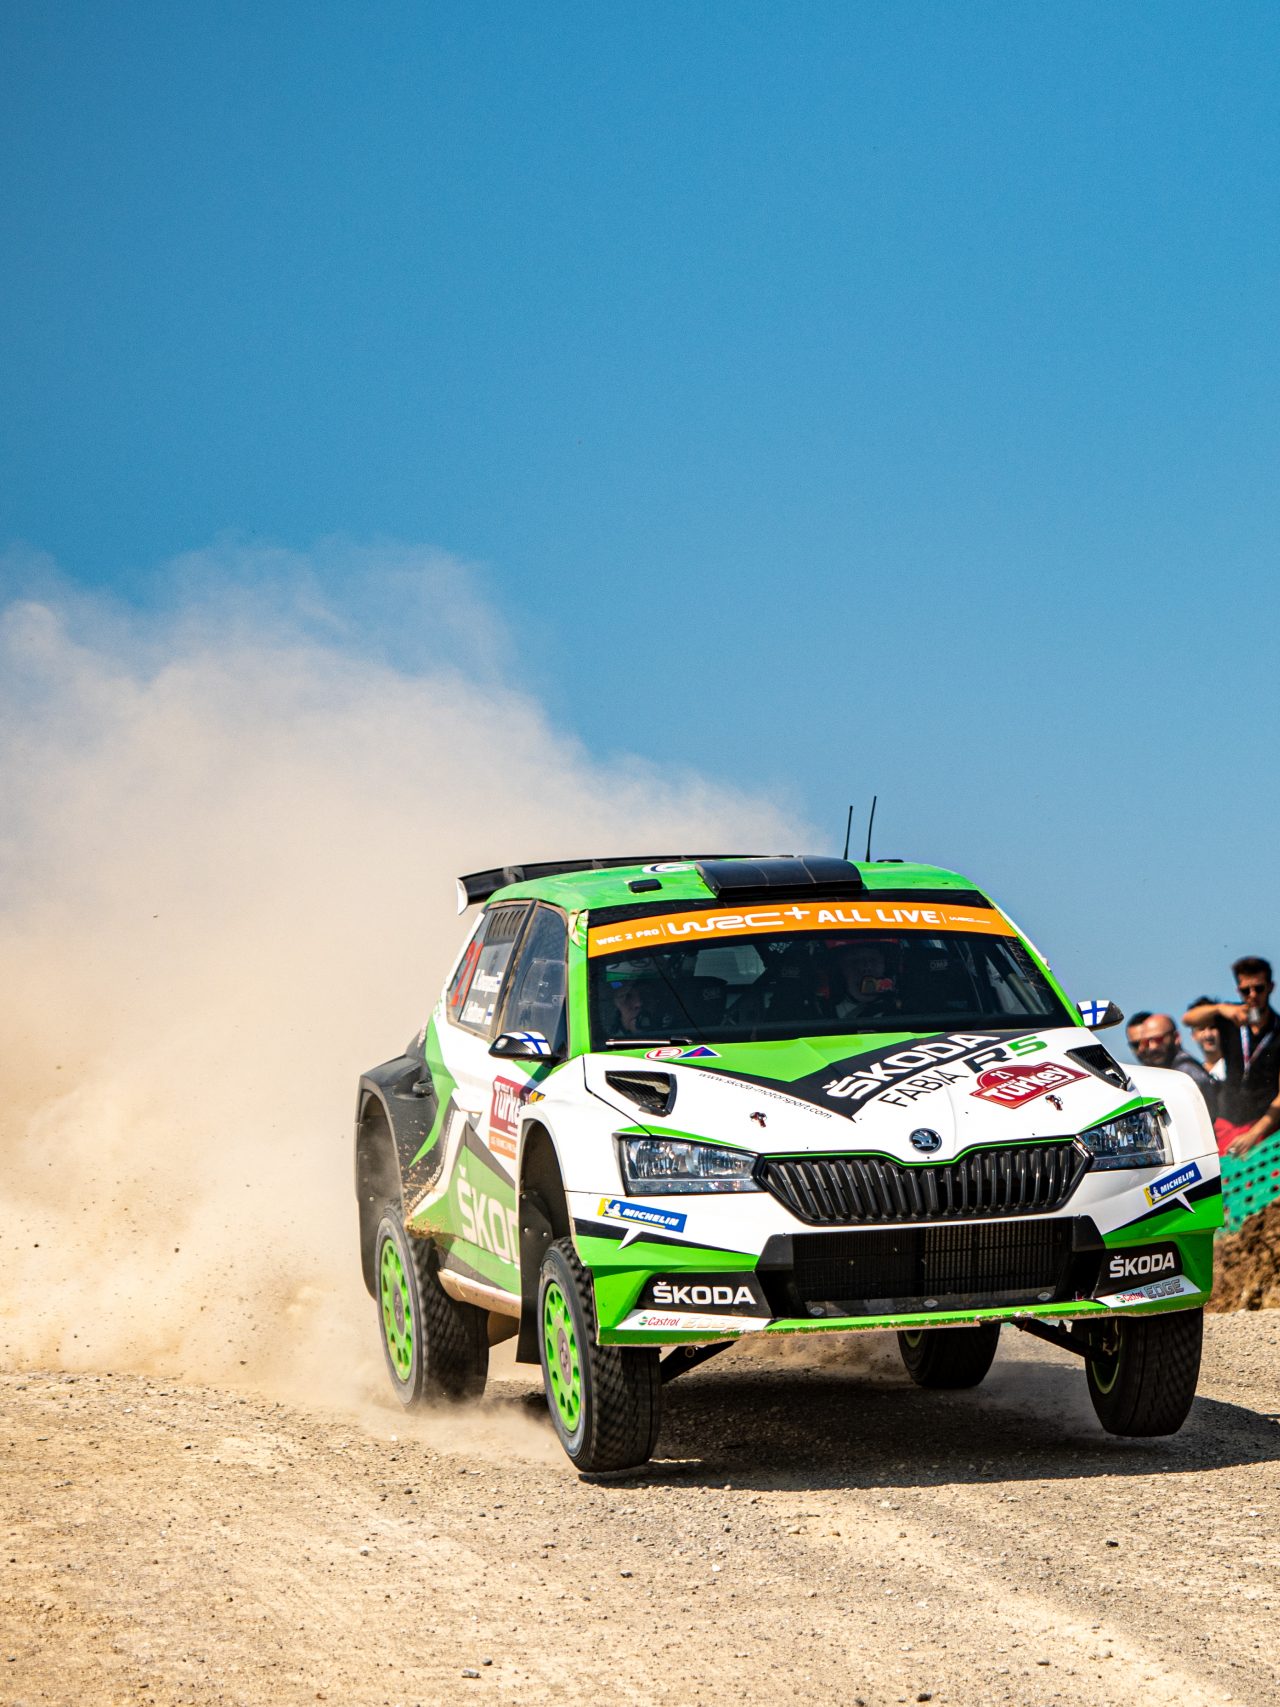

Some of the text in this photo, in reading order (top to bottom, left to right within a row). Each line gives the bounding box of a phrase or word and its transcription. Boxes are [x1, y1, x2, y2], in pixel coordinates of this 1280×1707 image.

[818, 909, 941, 924] ALL LIVE
[596, 934, 622, 946] WRC
[636, 928, 660, 938] PRO
[822, 1034, 1000, 1100] ŠKODA
[962, 1035, 1048, 1074] R5
[699, 1073, 832, 1119] www.skoda-motorsport.com
[878, 1069, 969, 1107] FABIA
[981, 1065, 1076, 1101] Turkey
[1160, 1169, 1195, 1194] MICHELIN
[457, 1164, 520, 1270] ŠKOD
[622, 1208, 680, 1226] MICHELIN
[1109, 1252, 1175, 1279] ŠKODA
[652, 1281, 757, 1305] ŠKODA
[1123, 1279, 1184, 1303] Castrol EDGE
[647, 1316, 680, 1327] Castrol
